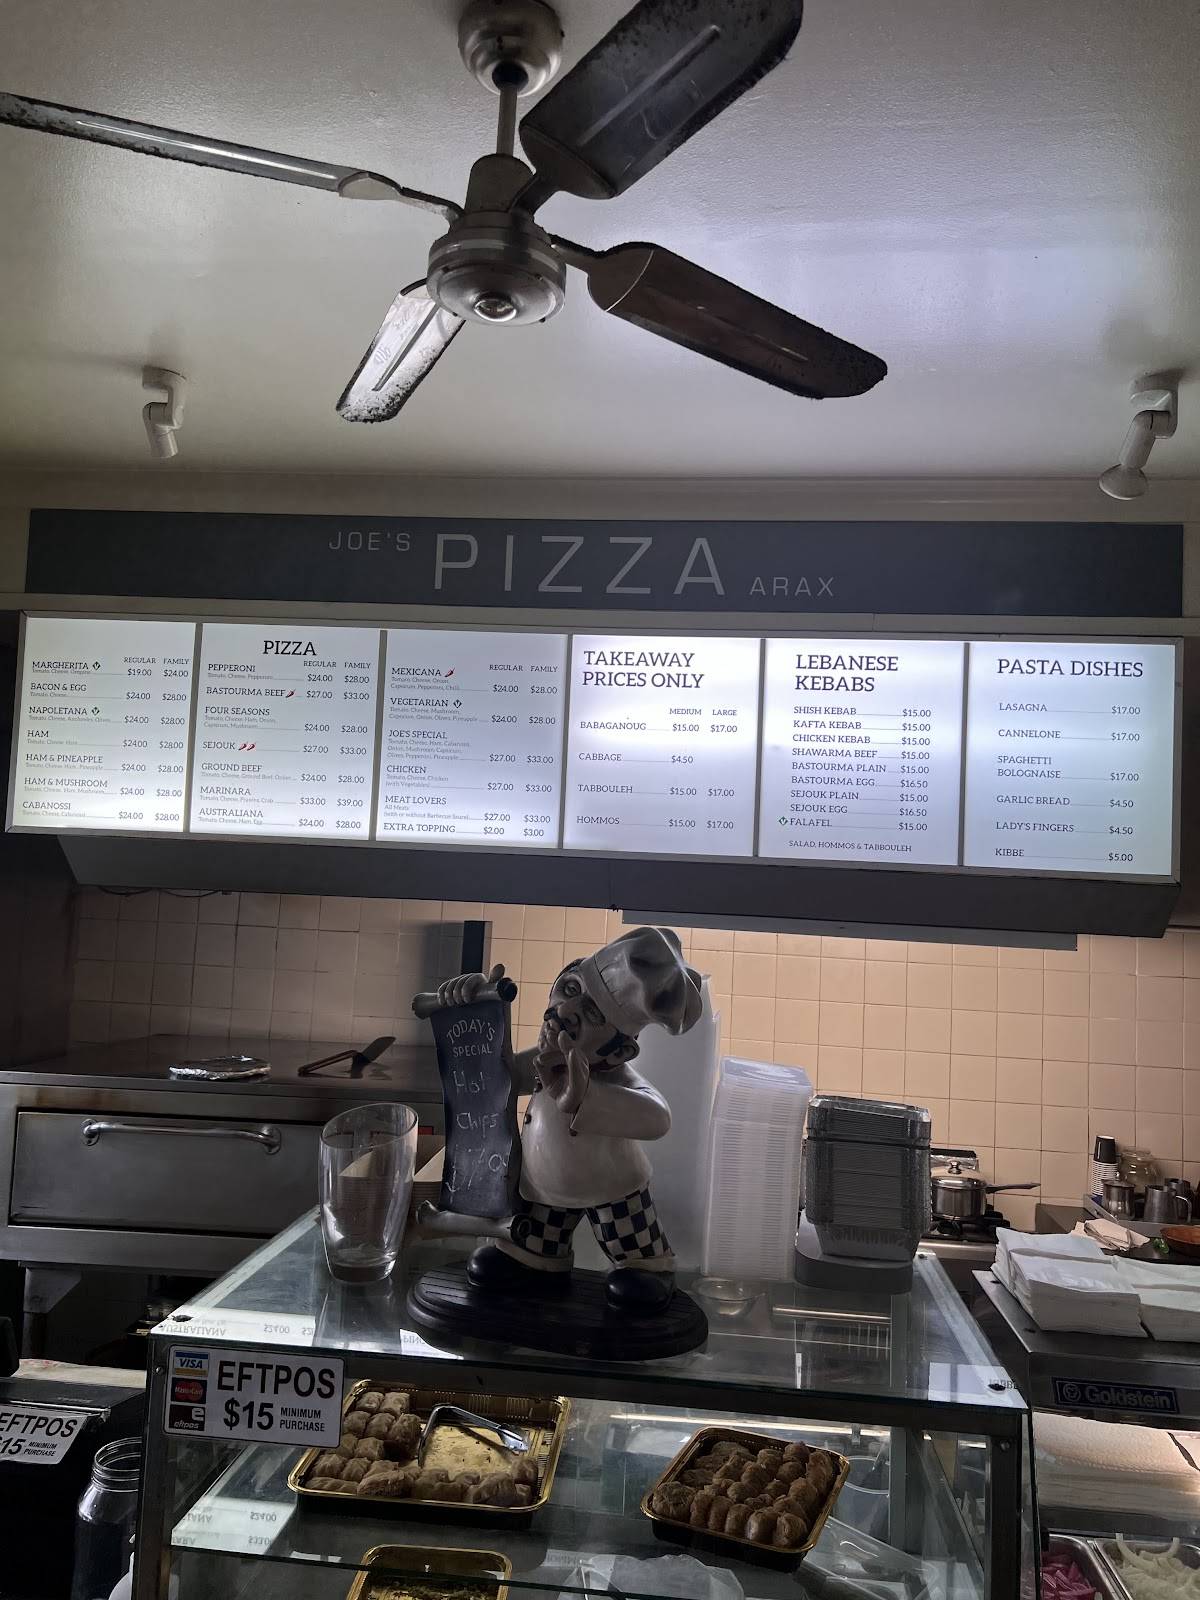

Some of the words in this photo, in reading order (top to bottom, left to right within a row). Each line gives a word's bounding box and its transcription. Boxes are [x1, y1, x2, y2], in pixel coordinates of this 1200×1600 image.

[328, 531, 411, 552] JOE'S
[434, 533, 725, 595] PIZZA
[749, 576, 834, 597] ARAX
[263, 640, 316, 656] PIZZA
[124, 656, 156, 664] REGULAR
[584, 651, 695, 667] TAKEAWAY
[796, 655, 899, 671] LEBANESE
[32, 661, 89, 670] MARGHERITA
[208, 664, 255, 672] PEPPERONI
[997, 659, 1064, 675] PASTA
[1070, 661, 1143, 677] DISHES
[127, 668, 152, 677] $19.00
[164, 669, 188, 678] $24.00
[392, 668, 441, 677] MEXICANA
[307, 674, 332, 683] $24.00
[344, 675, 369, 684] $28.00
[582, 672, 647, 687] PRICES
[651, 673, 704, 688] ONLY
[795, 676, 875, 692] KEBABS
[31, 683, 60, 691] BACON
[70, 684, 87, 692] EGG
[206, 687, 262, 696] BASTOURMA
[264, 689, 286, 697] BEEF
[493, 684, 519, 693] $24.00
[531, 686, 557, 694] $28.00
[126, 692, 150, 700] $24.00
[162, 693, 186, 702] $28.00
[306, 691, 332, 699] $27.00
[343, 692, 369, 700] $33.00
[390, 698, 448, 707] VEGETARIAN
[29, 706, 87, 715] NAPOLETANA
[205, 707, 229, 715] FOUR
[231, 707, 269, 716] SEASONS
[794, 706, 822, 715] SHISH
[824, 707, 856, 715] KEBAB
[903, 709, 931, 718] $15.00
[999, 703, 1047, 712] LASAGNA
[1112, 706, 1140, 715] $17.00
[491, 715, 517, 723] $24.00
[529, 716, 555, 725] $28.00
[304, 724, 329, 732] $24.00
[341, 725, 367, 734] $28.00
[580, 721, 646, 730] BABAGANOUG
[673, 723, 699, 732] $15.00
[711, 725, 737, 733] $17.00
[829, 721, 862, 729] KEBAB
[902, 723, 931, 731] $15.00
[27, 730, 49, 738] HAM
[389, 730, 410, 738] JOE'S
[412, 731, 447, 739] SPECIAL
[998, 730, 1061, 739] CANNELONE
[1111, 733, 1140, 742] $17.00
[793, 734, 836, 743] CHICKEN
[838, 736, 871, 744] KEBAB
[901, 737, 930, 746] $15.00
[203, 741, 235, 750] SEJOUK
[340, 747, 366, 755] $33.00
[792, 748, 852, 757] SHAWARMA
[854, 750, 878, 758] BEEF
[901, 751, 930, 760] $15.00
[26, 754, 48, 762] HAM
[57, 755, 103, 764] PINEAPPLE
[489, 754, 516, 763] $27.00
[527, 755, 553, 764] $33.00
[579, 753, 622, 761] CABBAGE
[672, 756, 693, 764] $4.50
[998, 756, 1051, 765] SPAGHETTI
[121, 763, 146, 772] $24.00
[158, 765, 183, 773] $28.00
[202, 763, 239, 772] GROUND
[241, 764, 262, 773] BEEF
[387, 765, 426, 774] CHICKEN
[792, 763, 854, 772] BASTOURMA
[856, 764, 886, 773] PLAIN
[901, 766, 929, 774] $15.00
[338, 775, 364, 784] $28.00
[998, 769, 1061, 779] BOLOGNAISE
[1110, 772, 1139, 781] $17.00
[24, 777, 46, 785] HAM
[55, 779, 108, 788] MUSHROOM
[791, 776, 853, 786] BASTOURMA
[856, 778, 875, 787] EGG
[900, 779, 928, 788] $16.50
[120, 788, 144, 796] $24.00
[156, 789, 182, 798] $28.00
[200, 786, 251, 796] MARINARA
[488, 783, 514, 791] $27.00
[525, 784, 552, 793] $33.00
[578, 784, 633, 793] TABBOULEH
[670, 787, 697, 796] $15.00
[708, 789, 734, 797] $17.00
[385, 796, 410, 804] MEAT
[413, 796, 447, 805] LOVERS
[791, 790, 827, 799] SEJOUK
[829, 791, 859, 800] PLAIN
[900, 794, 928, 803] $15.00
[997, 795, 1033, 805] GARLIC
[1036, 797, 1070, 805] BREAD
[1110, 799, 1133, 808] $4.50
[22, 801, 71, 810] CABANOSSI
[300, 797, 326, 806] $33.00
[337, 798, 363, 807] $39.00
[199, 808, 263, 818] AUSTRALIANA
[790, 804, 826, 813] SEJOUK
[829, 806, 847, 814] EGG
[900, 808, 927, 817] $16.50
[484, 813, 510, 822] $27.00
[524, 814, 551, 823] $33.00
[577, 816, 620, 825] HOMMOS
[669, 819, 696, 828] $15.00
[707, 820, 733, 829] $17.00
[336, 820, 361, 829] $28.00
[790, 818, 832, 827] FALAFEL
[899, 823, 927, 831] $15.00
[996, 822, 1030, 831] LADY'S
[1033, 823, 1074, 832] FINGERS
[1109, 826, 1133, 835] $4.50
[384, 824, 414, 832] EXTRA
[416, 824, 455, 833] TOPPING
[484, 826, 504, 835] $2.00
[523, 828, 544, 837] $3.00
[818, 842, 855, 850] HOMMOS
[864, 844, 911, 852] TABBOULEH
[995, 848, 1024, 856] KIBBE
[1108, 853, 1133, 862] $5.00
[447, 1019, 495, 1044] TODAY'S
[453, 1044, 492, 1057] SPECIAL
[179, 1358, 203, 1369] VISA
[217, 1361, 335, 1399] EFTPOS
[1085, 1386, 1170, 1408] Goldstein
[224, 1397, 274, 1430] $15
[280, 1407, 321, 1419] MINIMUM
[280, 1420, 325, 1431] PURCHASE
[0, 1437, 26, 1454] 15
